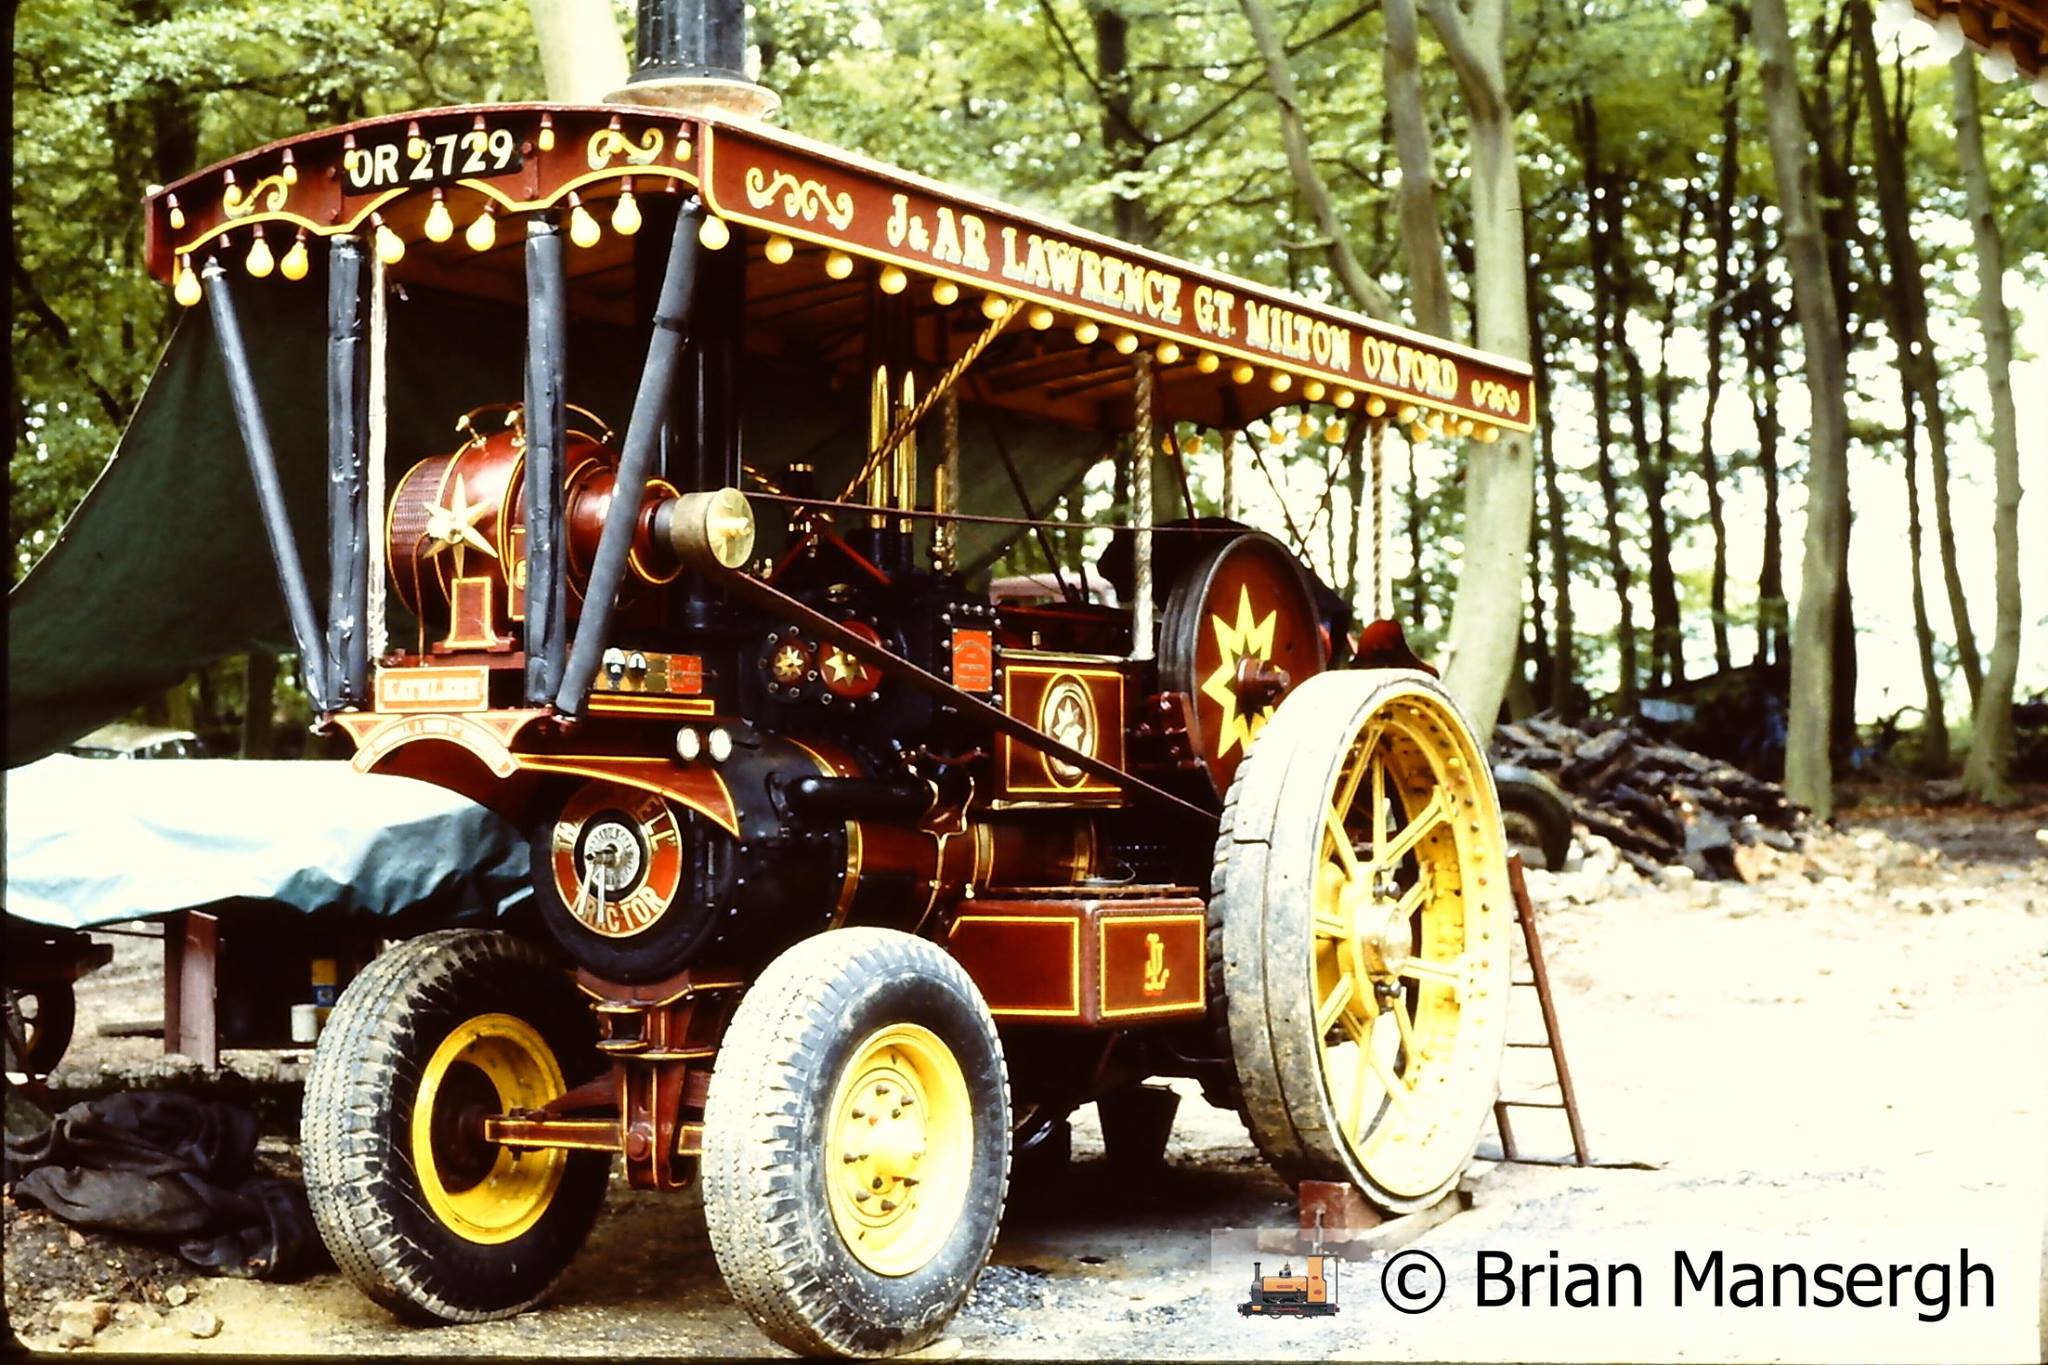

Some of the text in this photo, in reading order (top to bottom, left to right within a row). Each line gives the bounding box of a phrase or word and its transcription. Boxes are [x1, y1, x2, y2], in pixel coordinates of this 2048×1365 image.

[407, 128, 514, 182] 2729
[1001, 226, 1183, 326] LAWRENCE
[1244, 299, 1352, 373] MILTON
[1361, 335, 1459, 401] OXFORD
